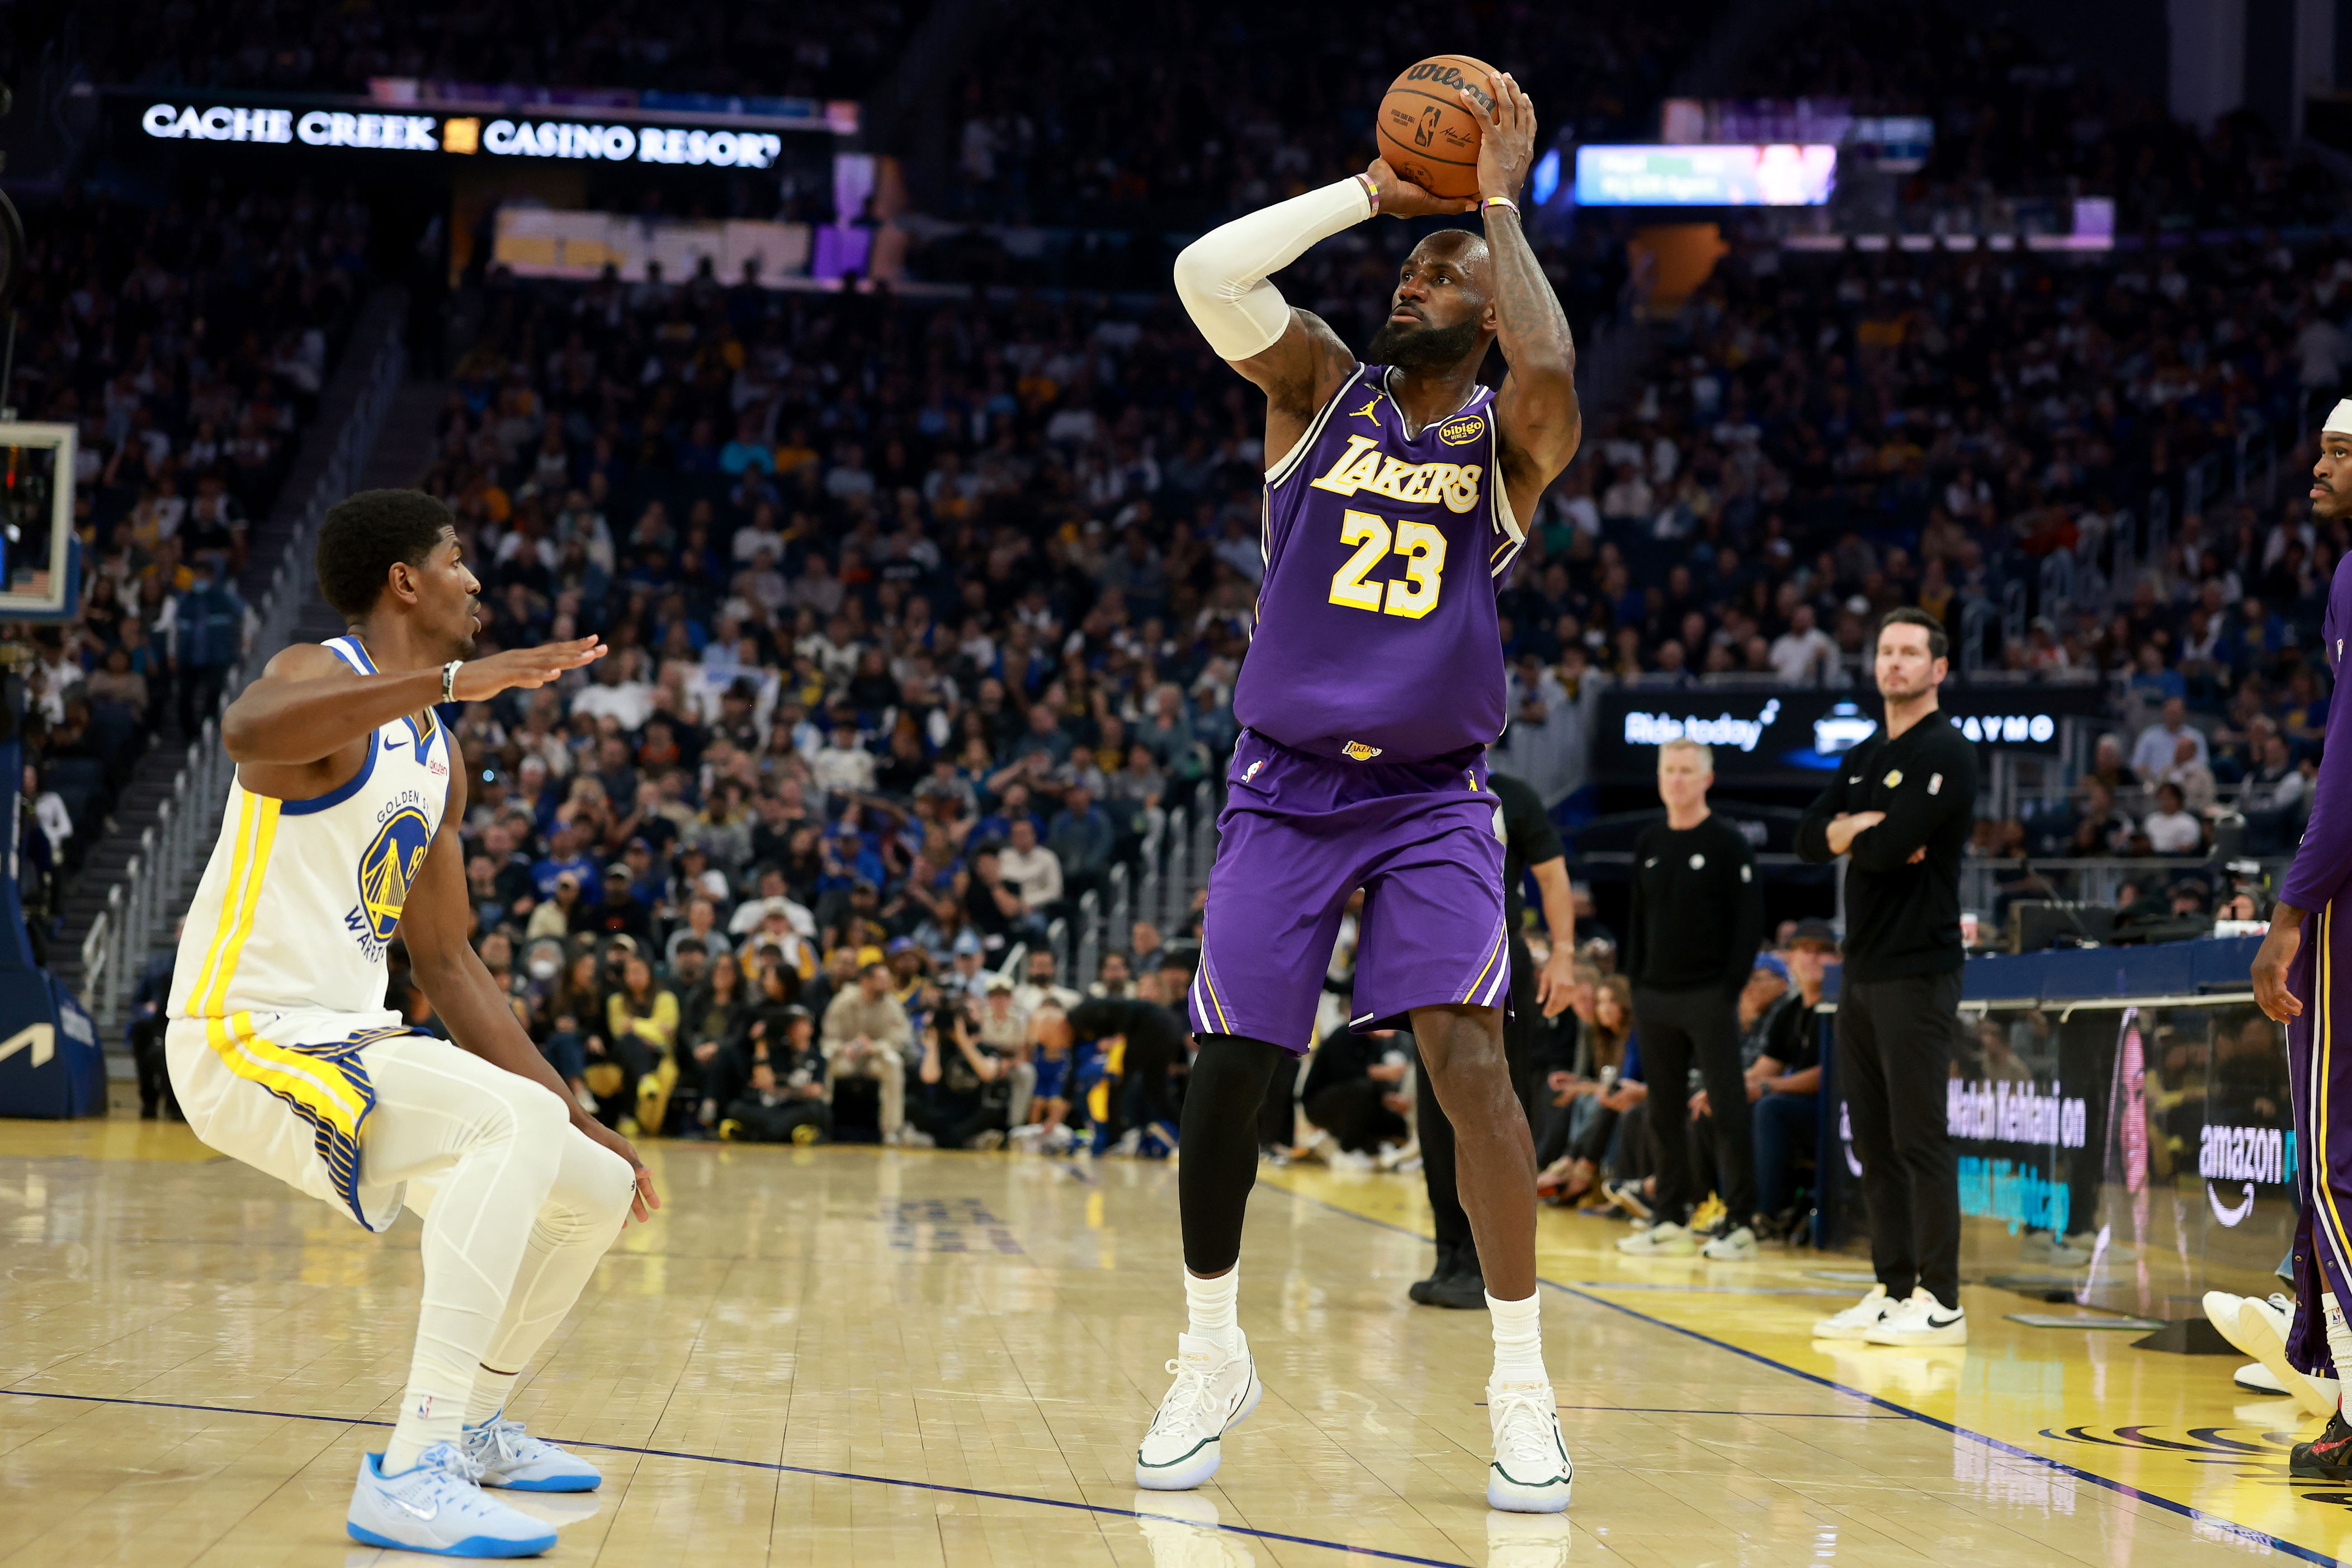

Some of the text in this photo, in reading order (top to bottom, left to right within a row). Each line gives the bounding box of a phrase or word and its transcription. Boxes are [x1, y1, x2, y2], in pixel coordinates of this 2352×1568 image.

[1407, 64, 1496, 114] Wilson
[142, 103, 293, 144] CACHE
[297, 111, 439, 151] CREEK
[483, 119, 636, 160] CASINO
[1443, 422, 1482, 437] bibigo
[1451, 432, 1468, 440] 비비고
[1310, 434, 1483, 513] LAKERS
[1328, 508, 1448, 620] 23
[1624, 711, 1762, 752] Ride today
[429, 758, 447, 776] akuten
[377, 790, 419, 823] GOLDEN
[344, 904, 386, 964] WARRI
[2061, 1097, 2086, 1148] on
[2199, 1124, 2282, 1184] amazon
